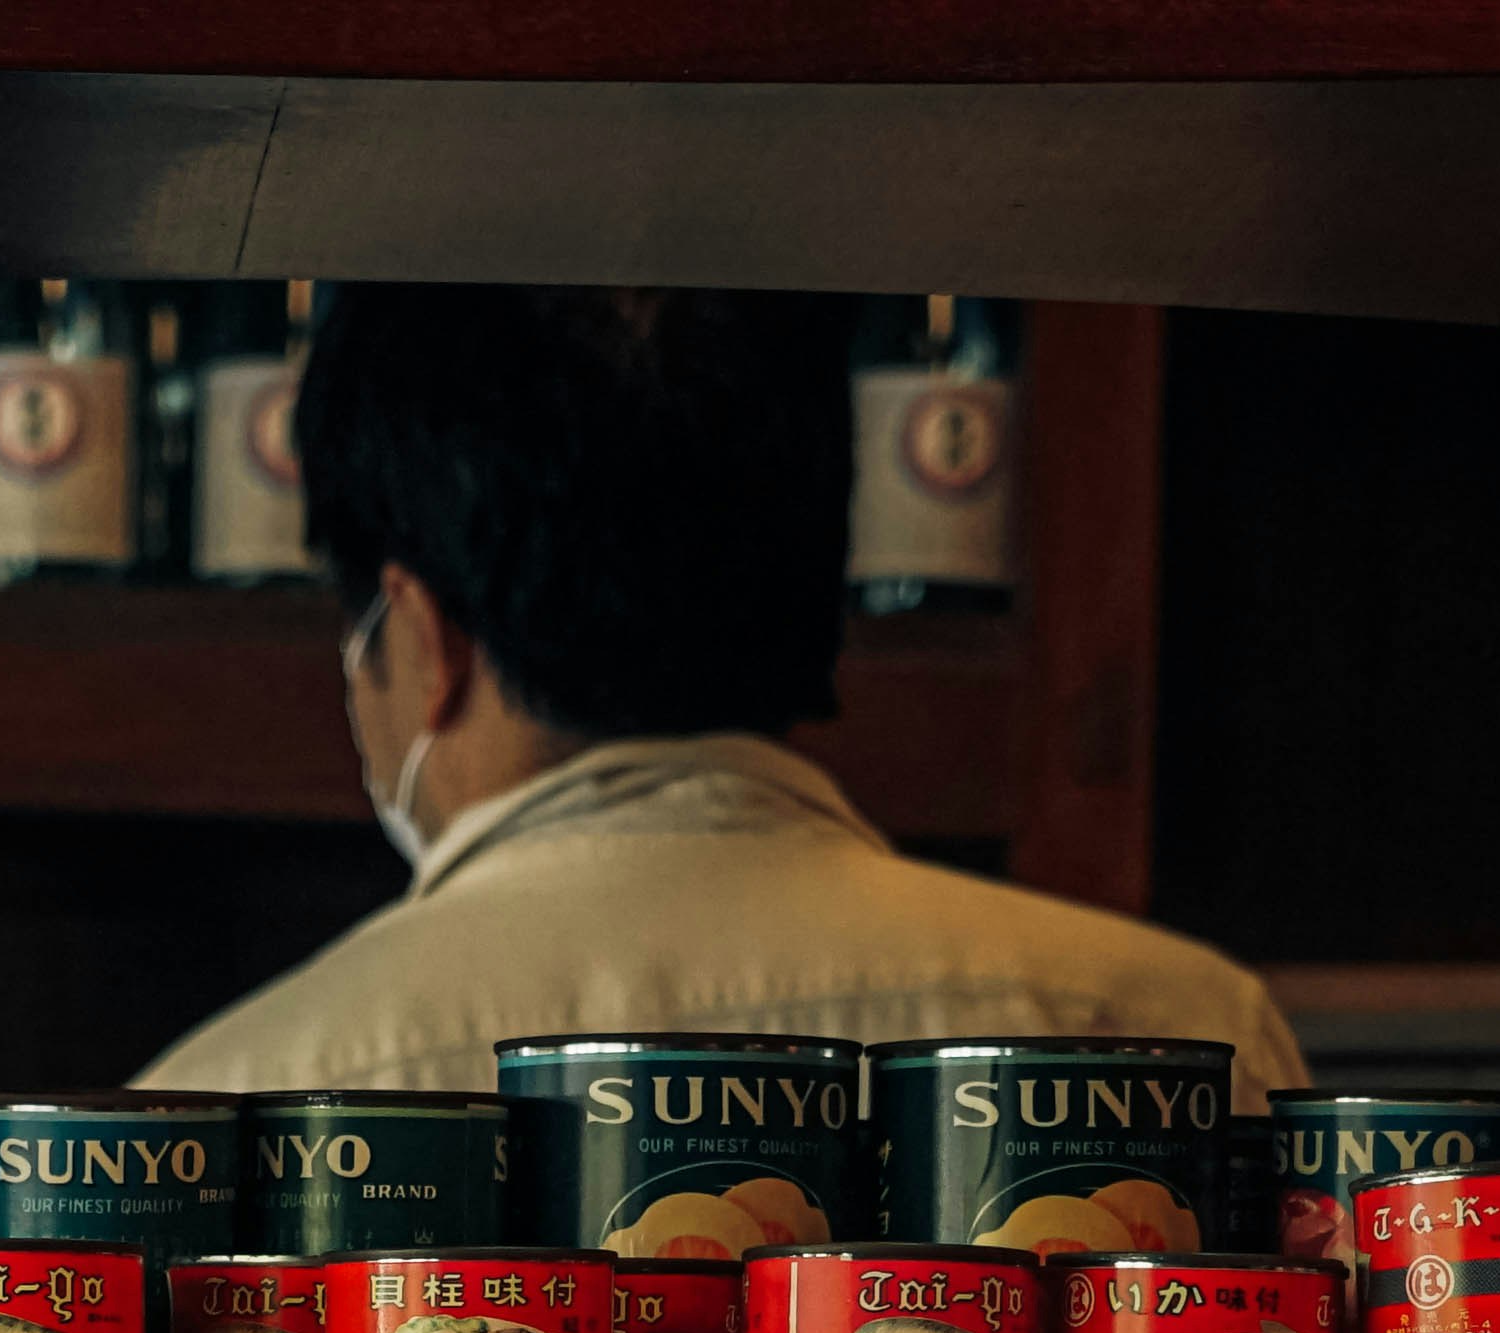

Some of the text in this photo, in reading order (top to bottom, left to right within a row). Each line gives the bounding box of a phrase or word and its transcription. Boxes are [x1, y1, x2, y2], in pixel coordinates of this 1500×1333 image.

[585, 1077, 848, 1129] SUNYO
[952, 1079, 1218, 1129] SUNYO
[0, 1138, 207, 1186] SUNYO
[638, 1137, 674, 1155] OUR
[685, 1137, 750, 1155] FINEST
[1003, 1140, 1039, 1158] OUR
[1050, 1140, 1116, 1158] FINEST
[21, 1197, 184, 1215] OUR FINEST QUALITY
[361, 1183, 438, 1201] BRAND
[369, 1272, 577, 1311] 貝柱味付
[1106, 1279, 1281, 1317] いか味付
